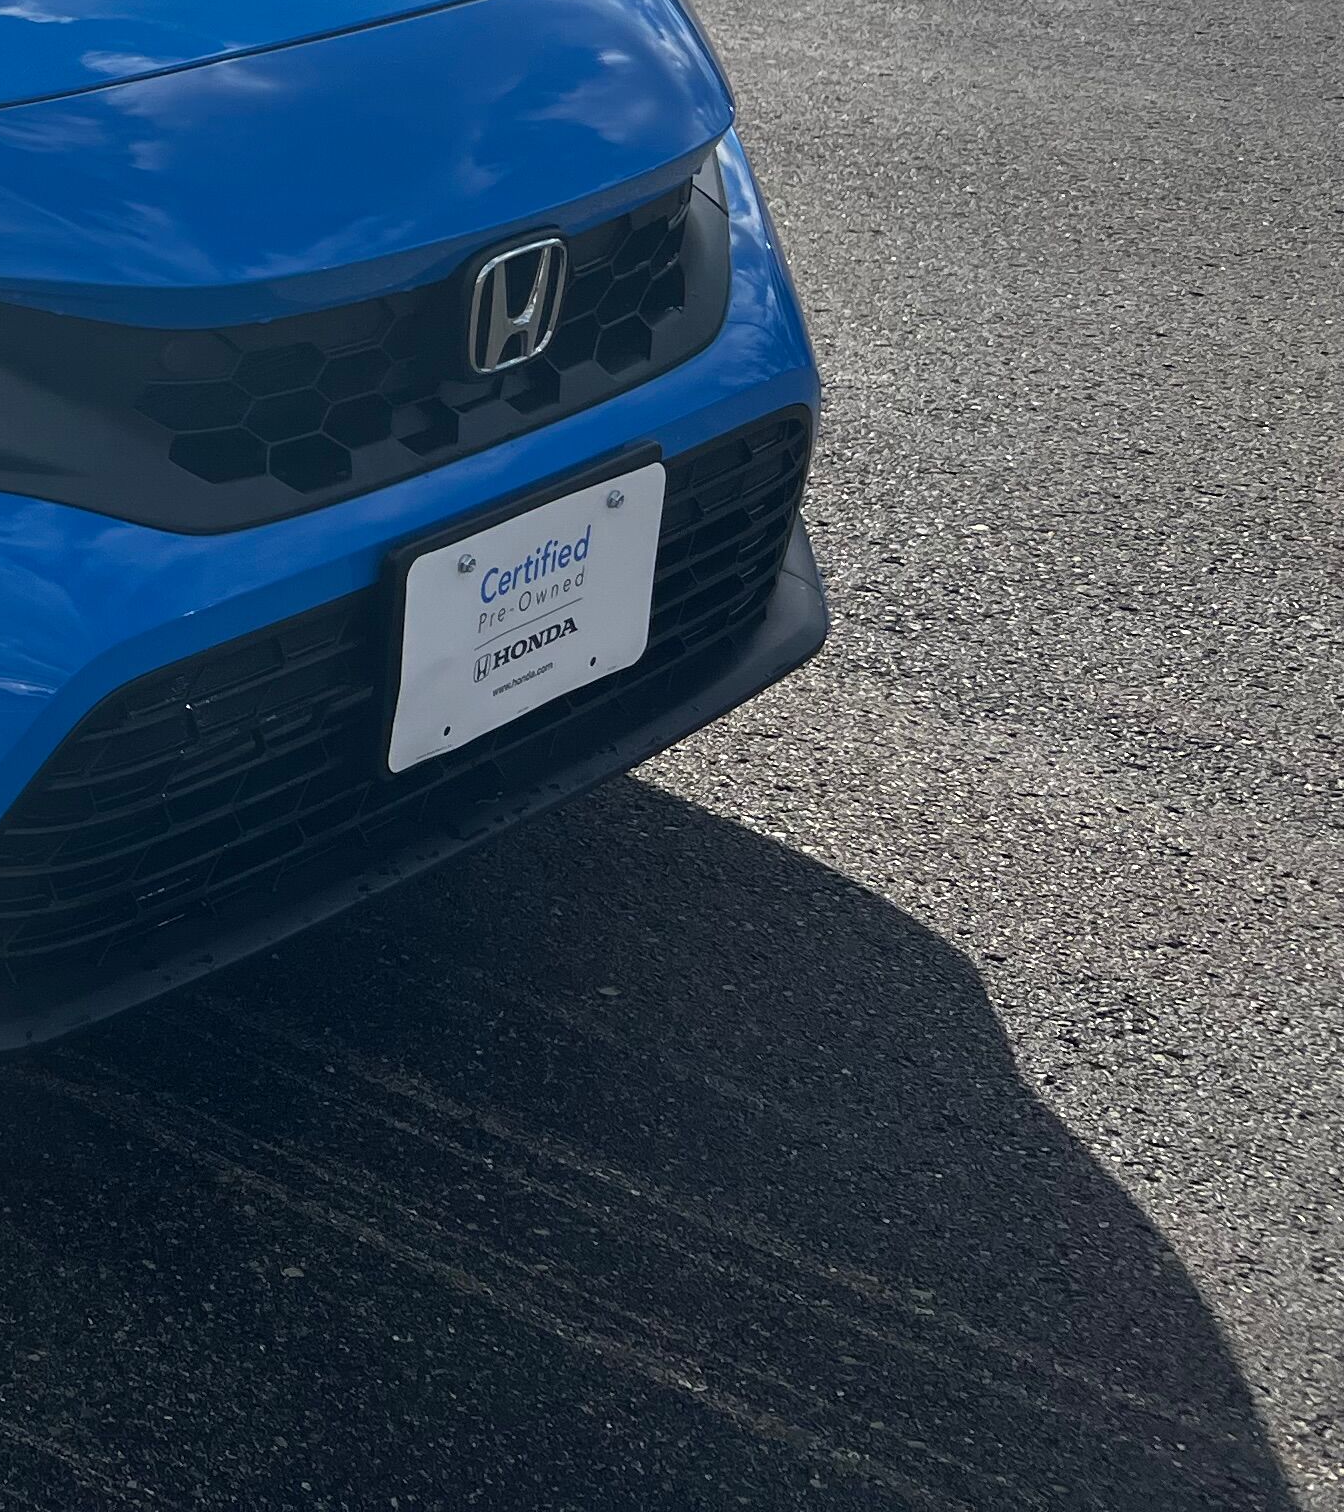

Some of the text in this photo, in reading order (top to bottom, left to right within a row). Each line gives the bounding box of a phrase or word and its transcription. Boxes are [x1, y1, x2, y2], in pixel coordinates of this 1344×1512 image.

[480, 524, 592, 604] Certified
[477, 567, 585, 634] Pre-Owned
[491, 617, 579, 671] HONDA
[492, 662, 554, 697] www.honda.com
